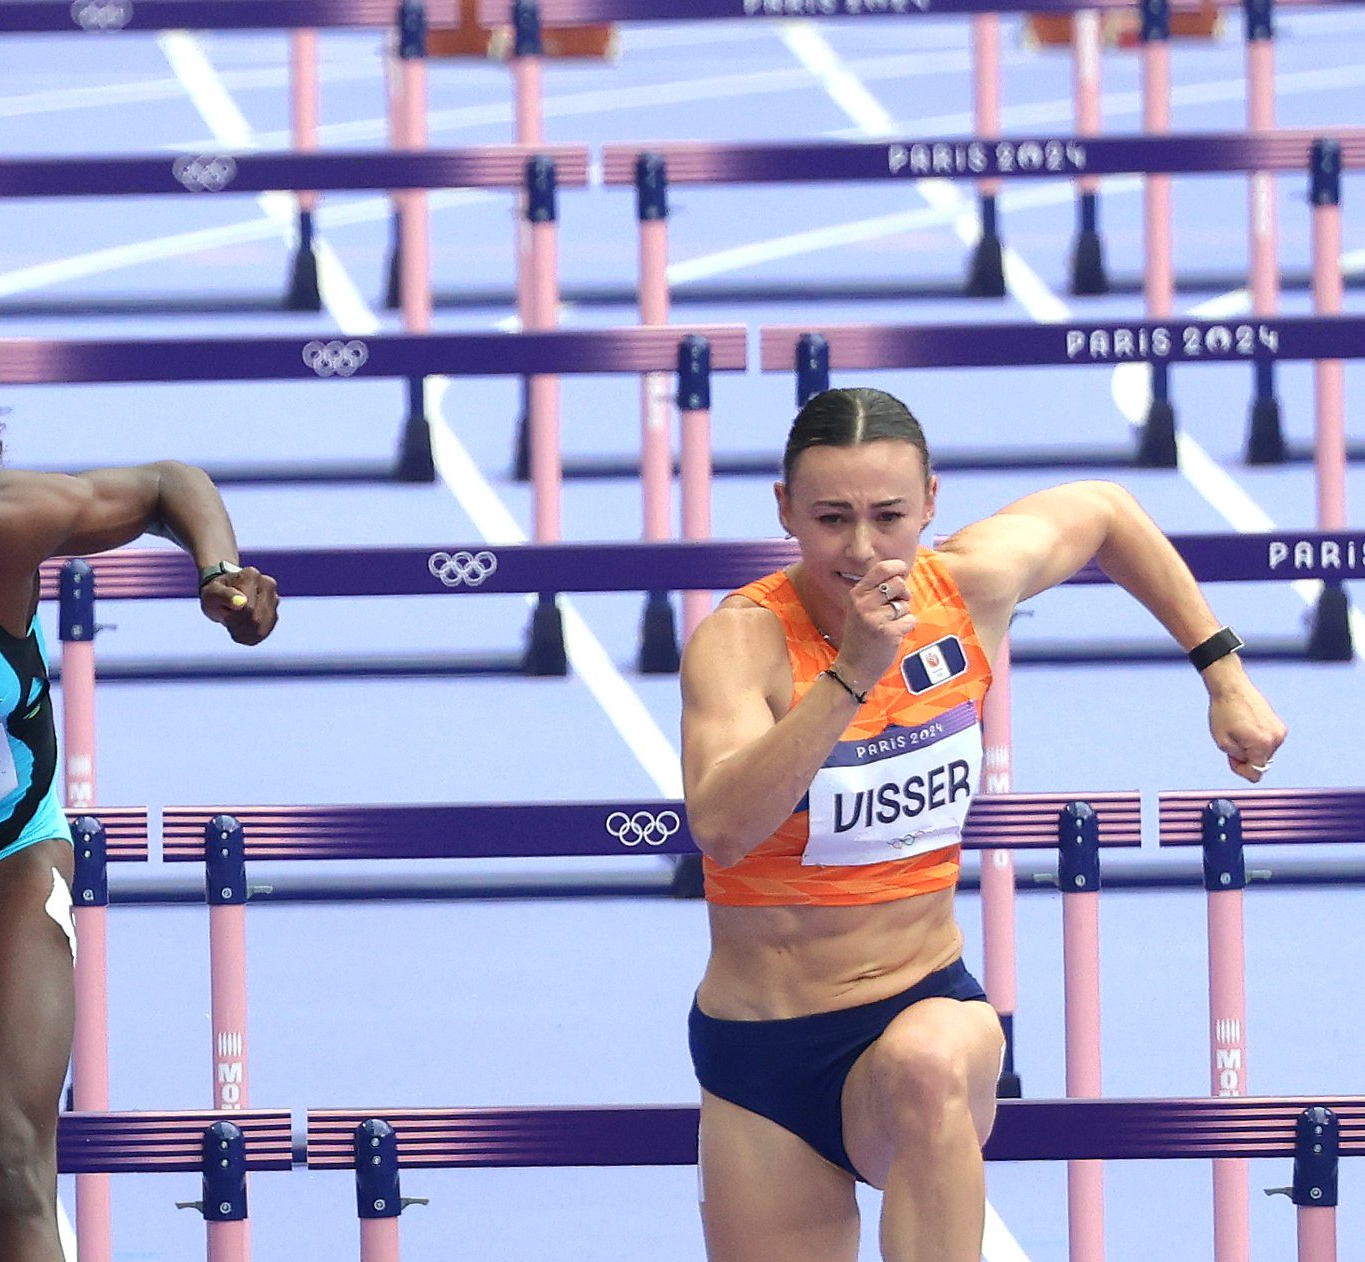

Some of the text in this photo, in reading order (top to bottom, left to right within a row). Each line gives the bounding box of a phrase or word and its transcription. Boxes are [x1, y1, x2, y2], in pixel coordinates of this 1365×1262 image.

[1183, 325, 1279, 357] 2024
[1269, 541, 1365, 570] PARI
[910, 722, 943, 744] 2024
[833, 759, 970, 833] VISSER
